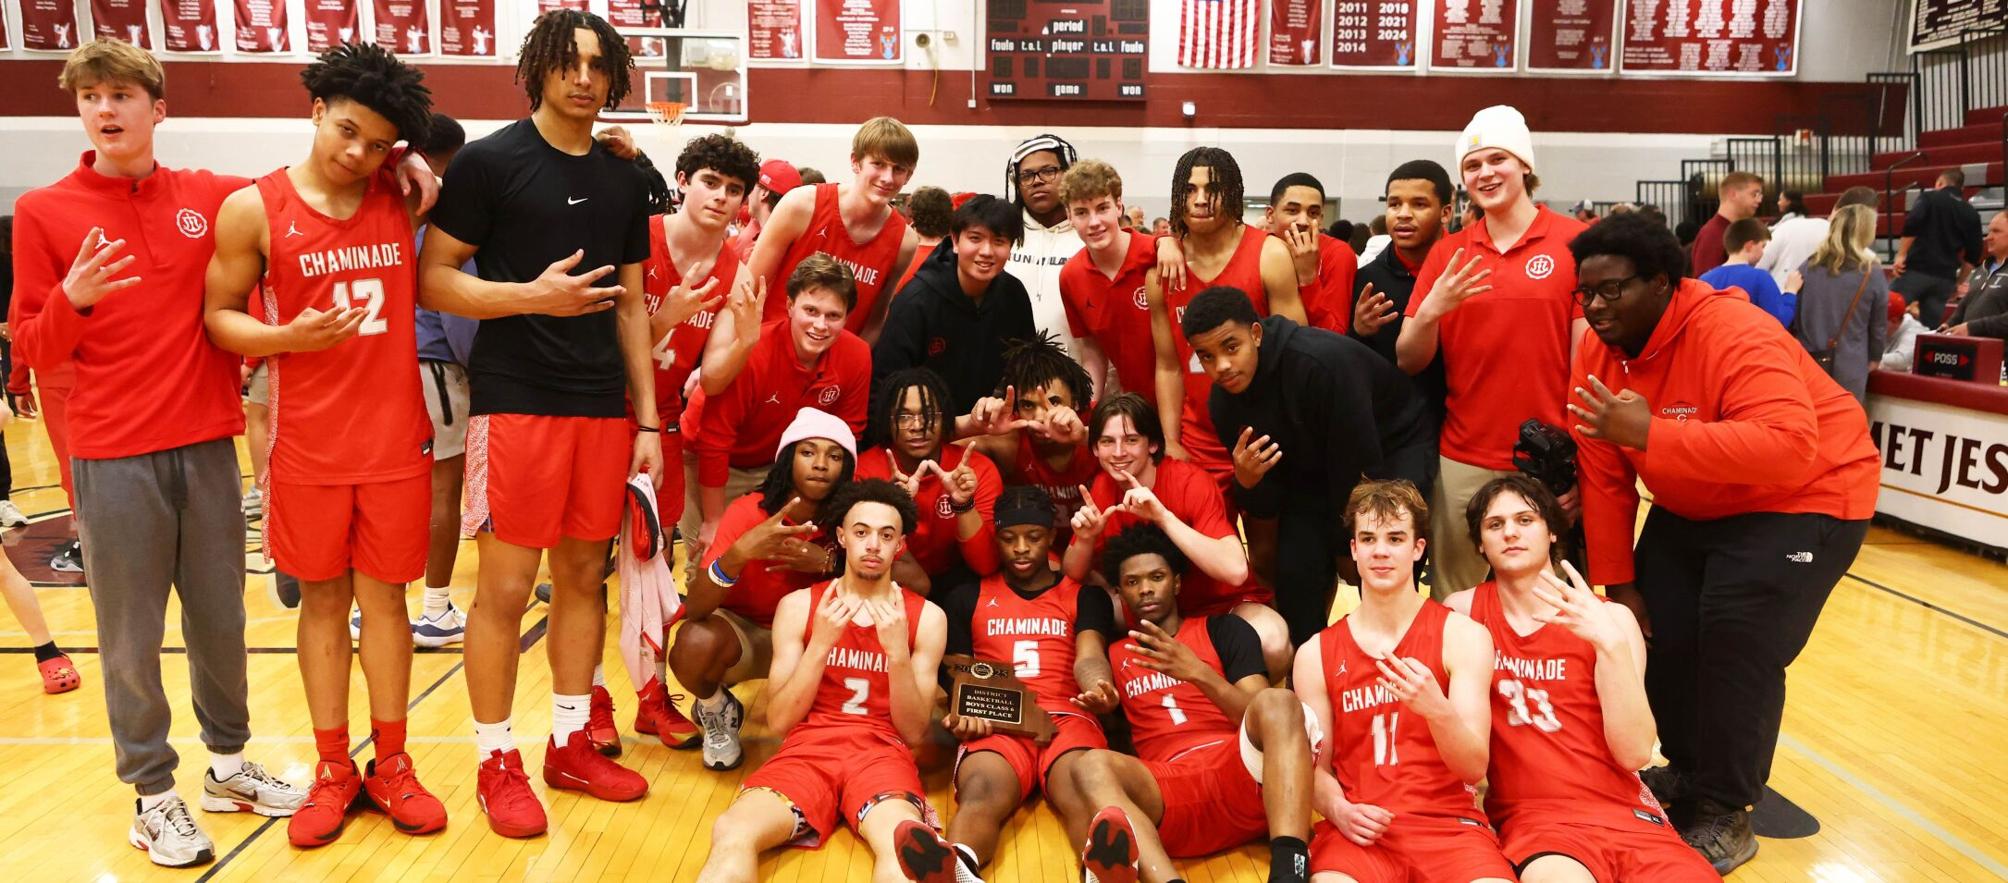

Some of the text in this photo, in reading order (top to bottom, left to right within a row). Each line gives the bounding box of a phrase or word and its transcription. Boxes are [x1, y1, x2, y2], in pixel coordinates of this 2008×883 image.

[1339, 2, 1409, 14] 2011 2018
[1053, 20, 1083, 34] period
[1338, 16, 1407, 27] 2012 2021
[1338, 29, 1407, 40] 2013 2024
[1052, 39, 1084, 53] player
[1337, 42, 1366, 53] 2014
[993, 84, 1013, 93] won
[1055, 85, 1080, 96] game
[1122, 86, 1142, 95] won
[299, 242, 402, 278] CHAMINADE
[333, 278, 389, 337] 12
[987, 616, 1067, 637] CHAMINADE
[1012, 640, 1040, 678] 5
[1493, 649, 1566, 681] HAMINADE
[841, 677, 869, 715] 2
[966, 694, 1014, 706] BASKETBALL
[965, 701, 985, 709] BOYS
[986, 704, 1009, 712] CLASS
[966, 707, 1013, 718] FIRST PLACE
[1161, 692, 1189, 727] 1
[1498, 678, 1563, 733] 33
[1371, 711, 1399, 769] 11
